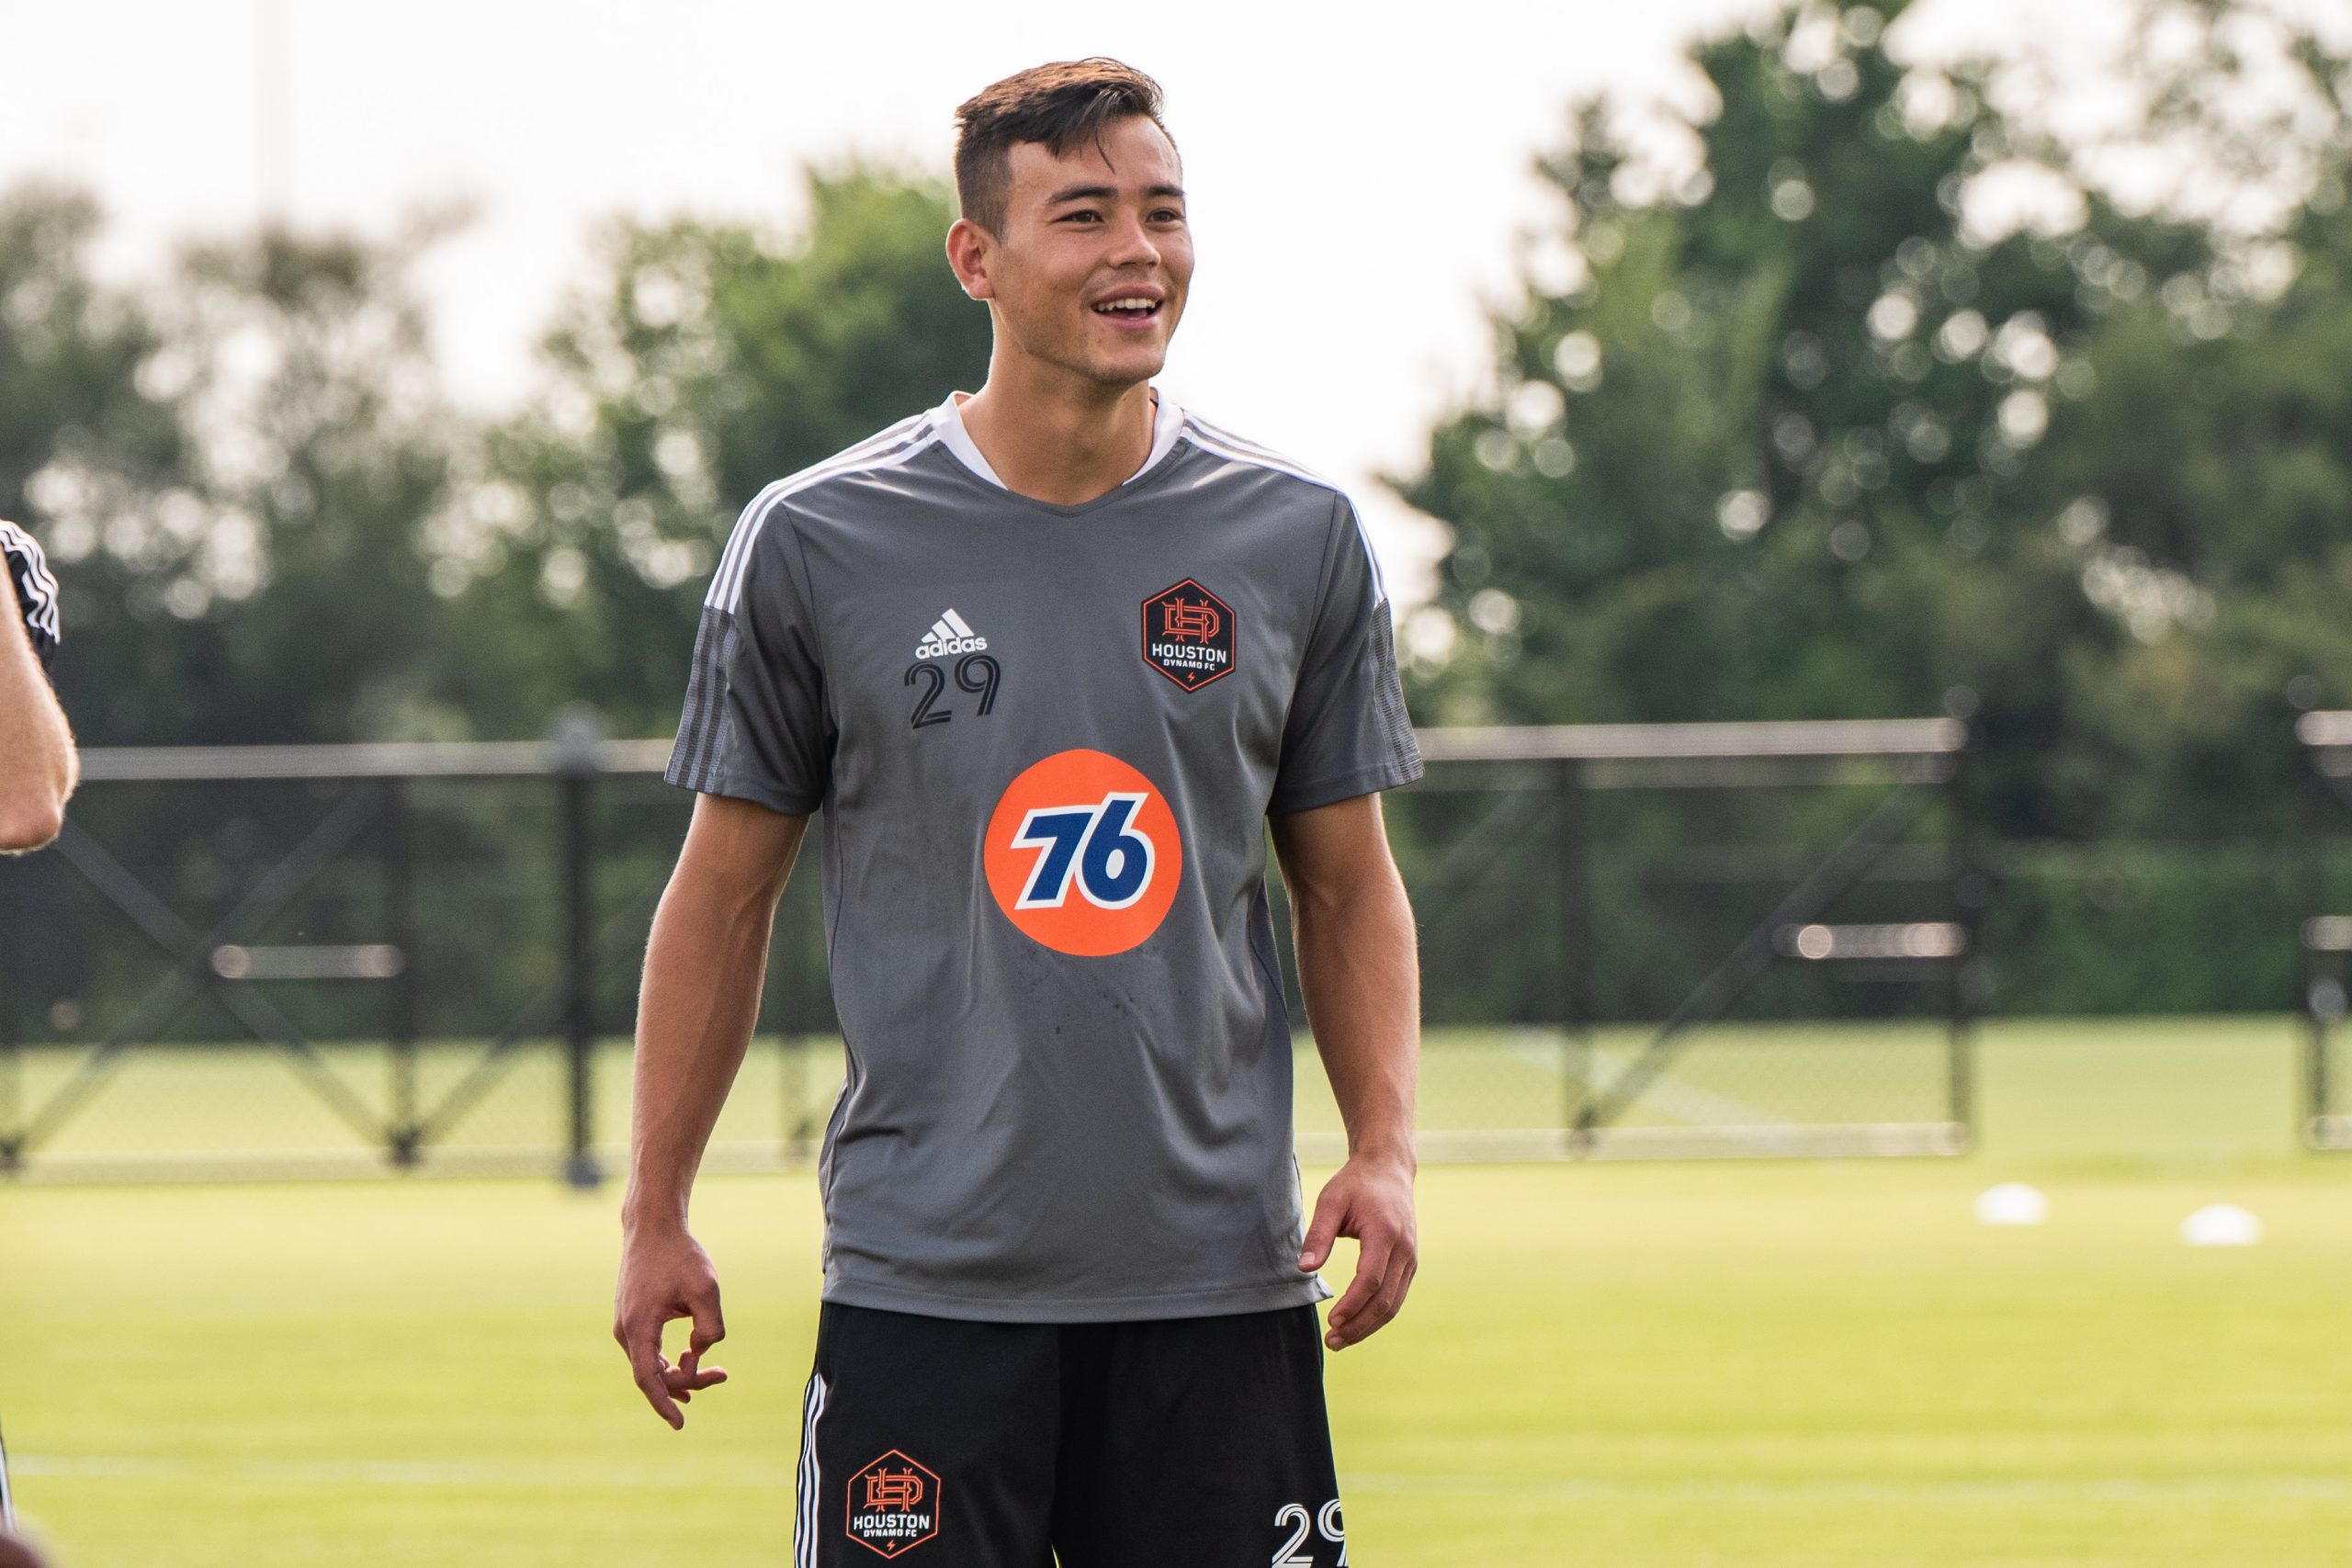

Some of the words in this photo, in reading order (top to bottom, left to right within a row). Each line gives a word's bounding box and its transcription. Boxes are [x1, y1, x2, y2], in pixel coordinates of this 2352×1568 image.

[915, 637, 988, 660] adidas
[1151, 643, 1227, 663] HOUSTON
[1163, 659, 1203, 670] DYNAMO
[904, 653, 1001, 729] 29
[1010, 791, 1156, 910] 76
[854, 1514, 930, 1530] HOUSTON
[864, 1529, 904, 1537] DYNAMO
[905, 1529, 917, 1537] FC
